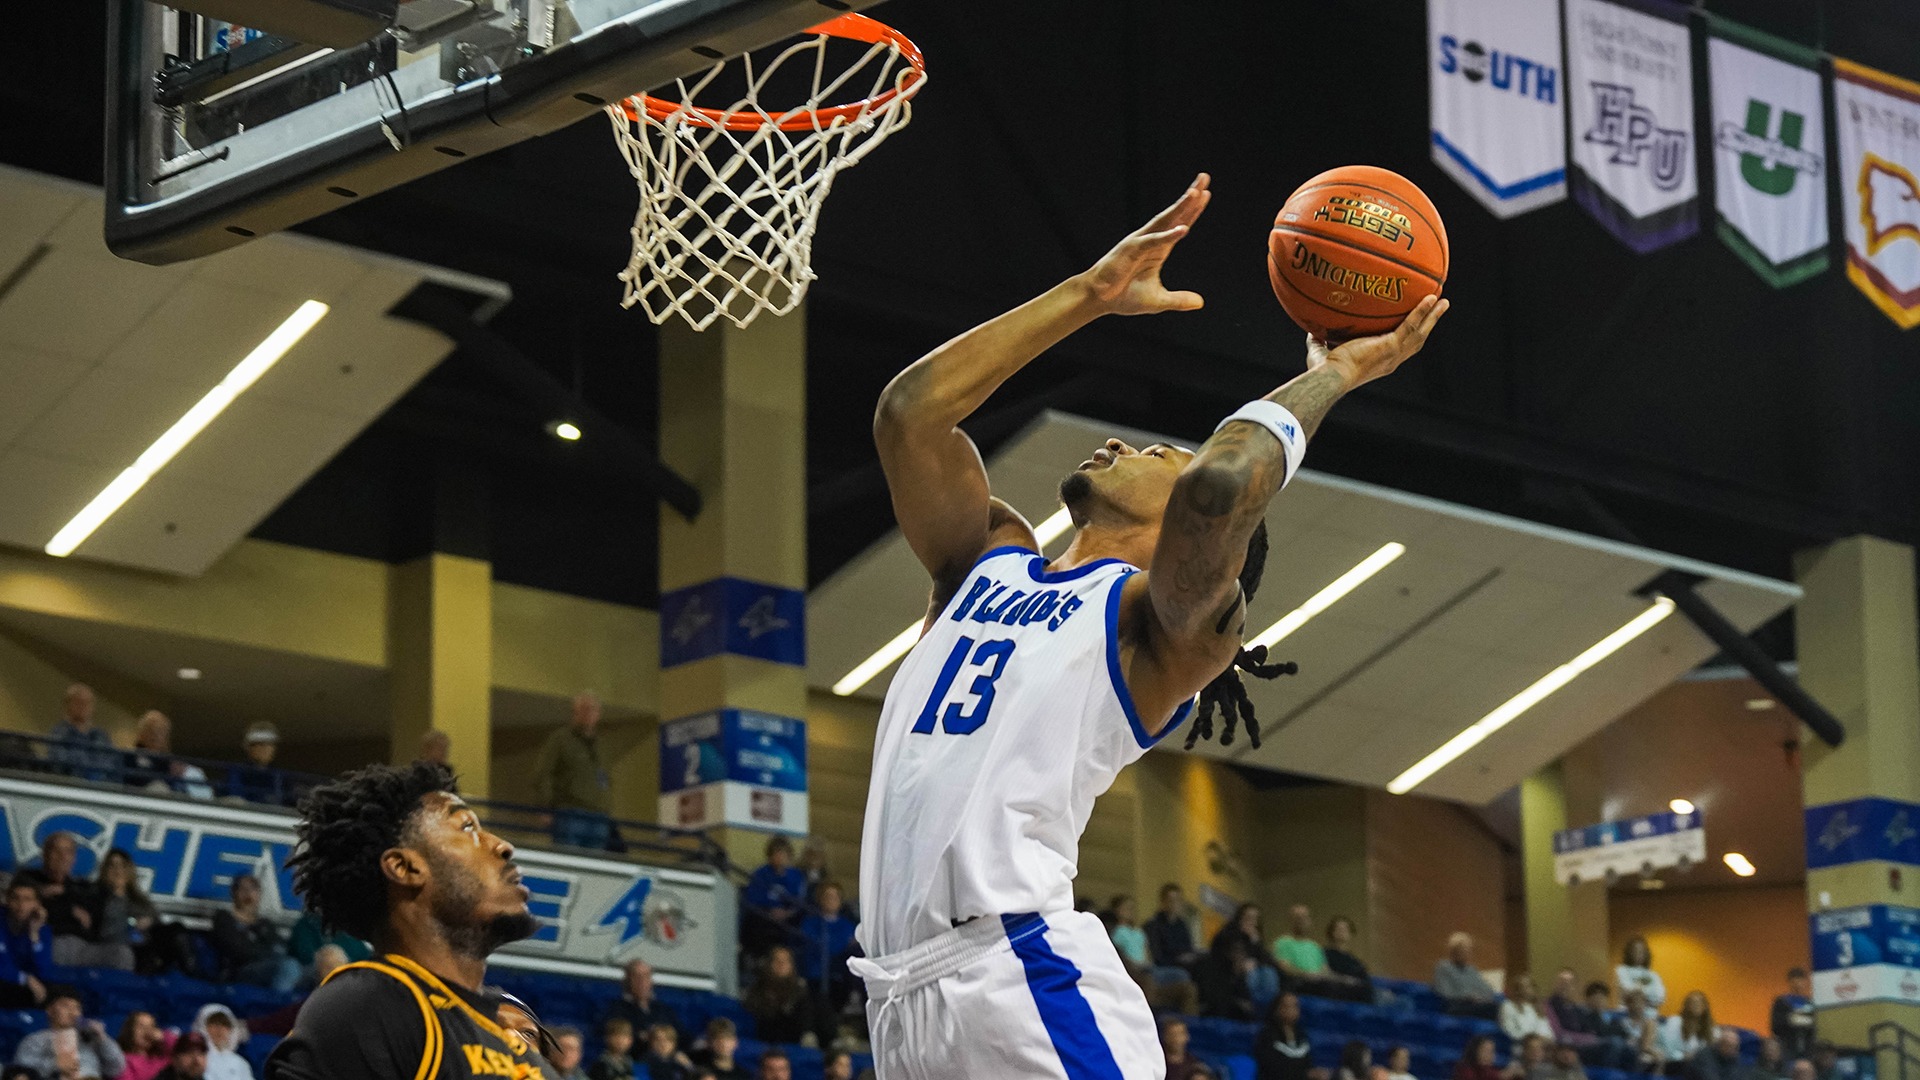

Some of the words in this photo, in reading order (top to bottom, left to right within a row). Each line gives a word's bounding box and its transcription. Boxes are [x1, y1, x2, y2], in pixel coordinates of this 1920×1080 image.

[1314, 205, 1415, 251] LEGACY
[1291, 240, 1408, 302] SPALDING
[910, 635, 1017, 736] 13
